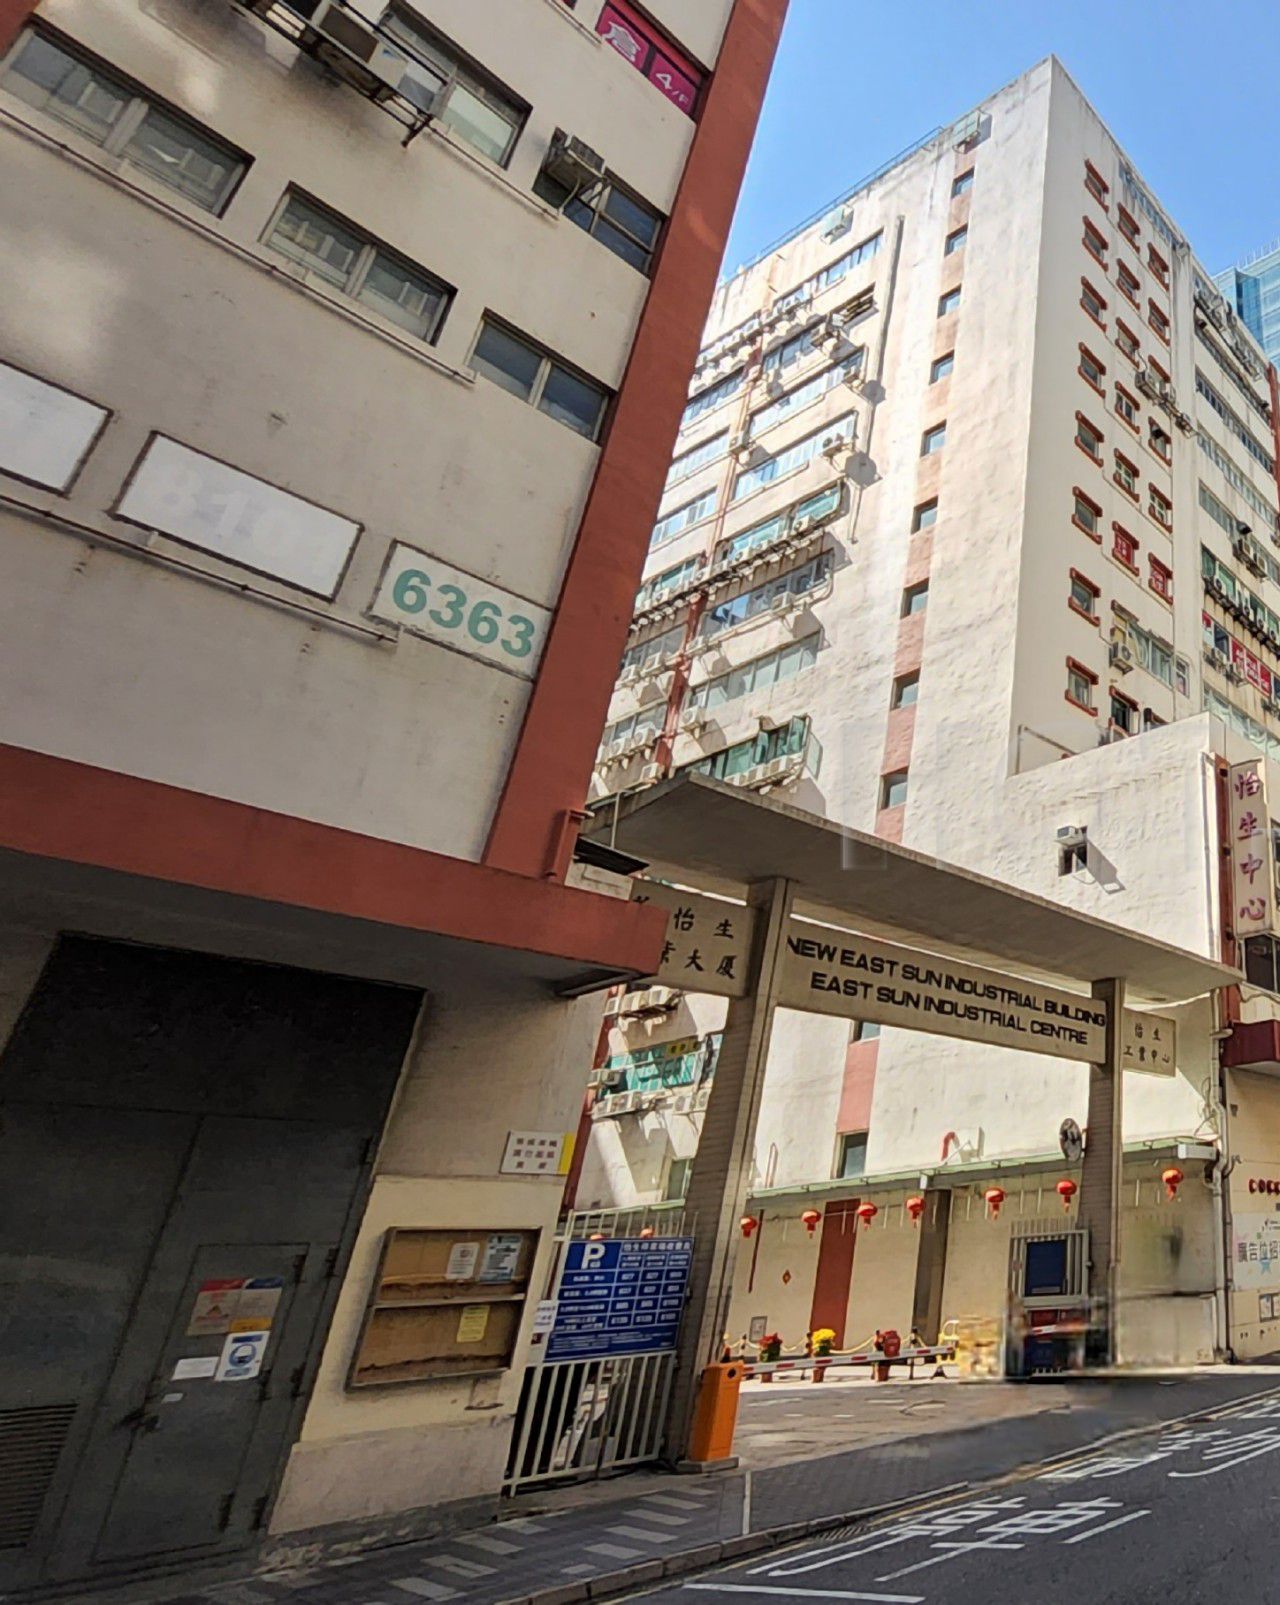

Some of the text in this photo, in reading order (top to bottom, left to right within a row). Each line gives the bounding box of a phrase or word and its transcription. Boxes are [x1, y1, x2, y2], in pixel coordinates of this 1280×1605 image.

[393, 569, 535, 657] 6363
[1234, 770, 1266, 921] 怡生中心
[787, 935, 1107, 1027] NEW EAST SUN INDUSTRIAL BUILDING
[811, 971, 1088, 1045] EAST SUN INDUSTRIAL CENTRE
[580, 1243, 606, 1270] P
